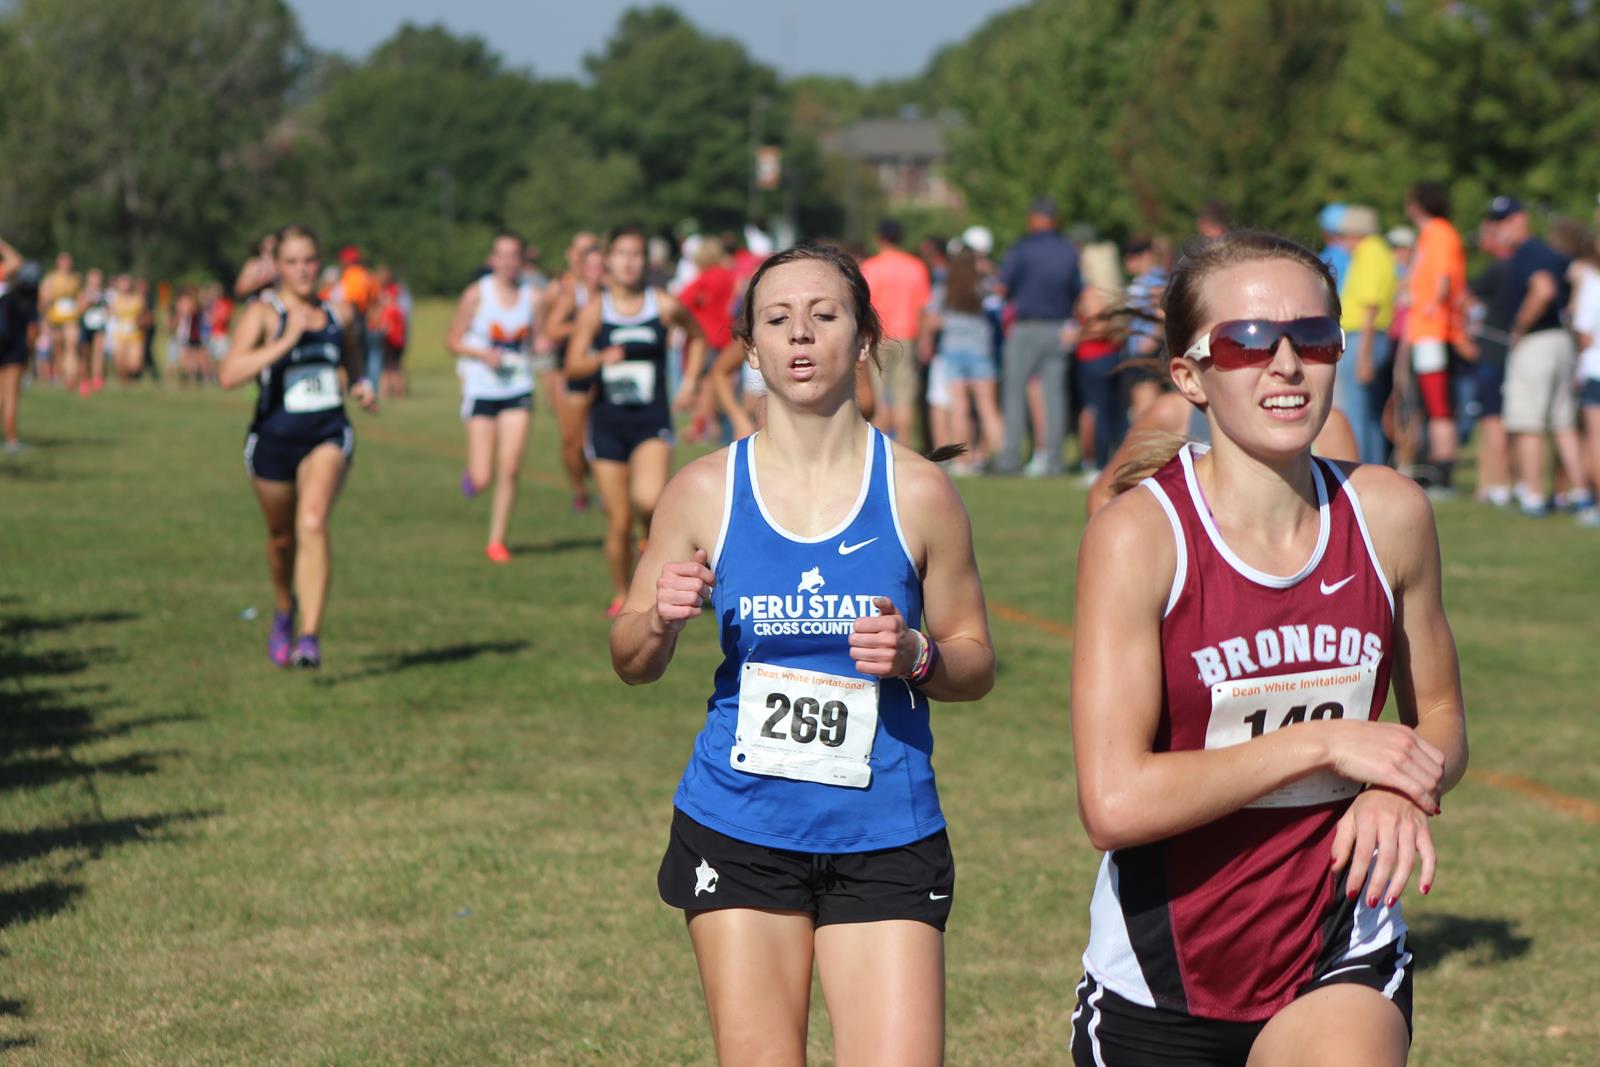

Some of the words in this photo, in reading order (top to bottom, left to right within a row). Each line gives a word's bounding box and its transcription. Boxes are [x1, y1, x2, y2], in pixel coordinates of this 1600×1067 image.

[740, 595, 804, 620] PERU
[753, 622, 800, 636] CROSS
[801, 621, 854, 635] COUNT
[1191, 624, 1382, 688] BRONCOS
[757, 668, 779, 679] Dean
[782, 671, 809, 684] White
[812, 676, 865, 690] Invitational
[1232, 684, 1261, 698] Dean
[1264, 682, 1296, 693] White
[1300, 672, 1361, 689] Invitational
[760, 692, 849, 748] 269
